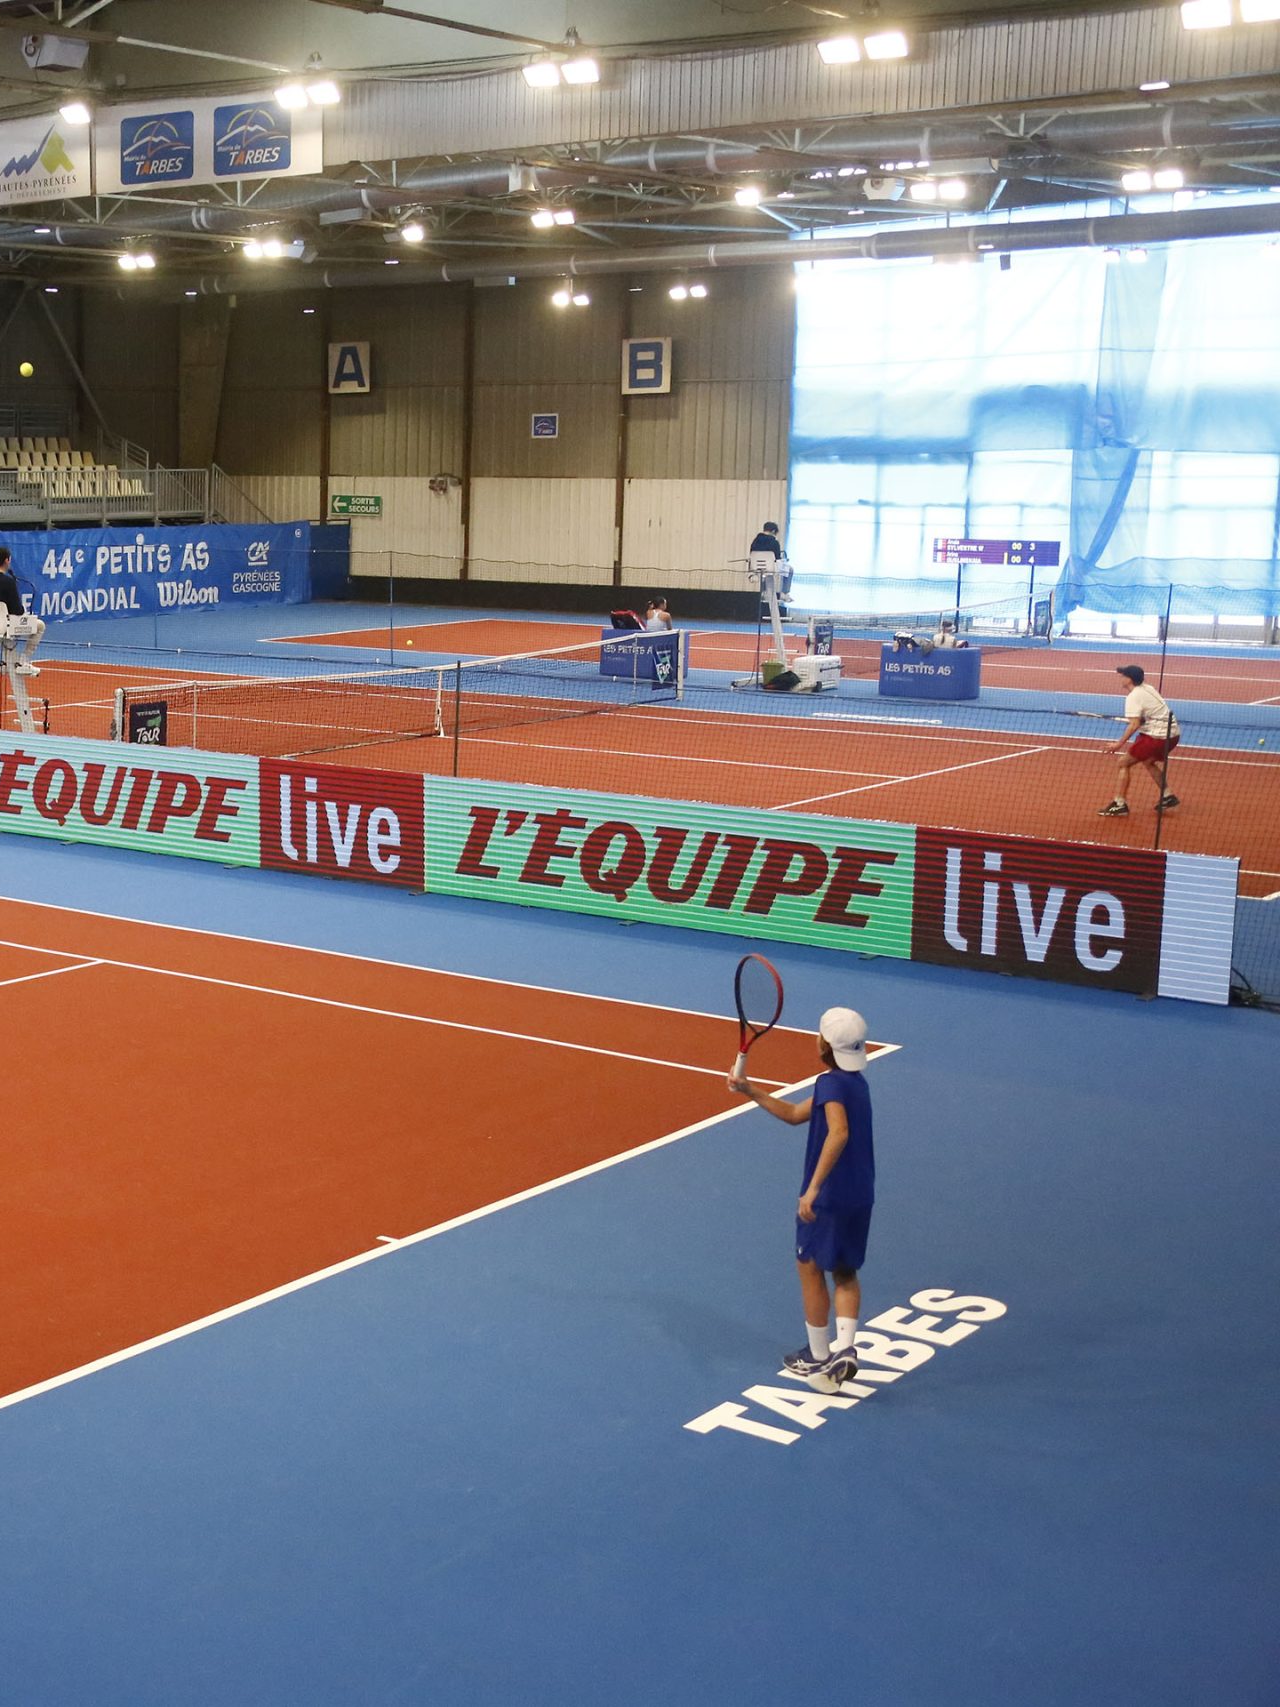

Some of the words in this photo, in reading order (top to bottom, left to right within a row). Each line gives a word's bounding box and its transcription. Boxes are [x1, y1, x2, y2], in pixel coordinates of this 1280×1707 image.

[229, 147, 280, 166] TARBES
[135, 157, 184, 176] TARBES
[332, 346, 366, 389] A
[629, 342, 663, 389] B
[348, 505, 380, 513] SECOURS
[351, 497, 375, 505] SORTIE
[42, 549, 85, 579] 44e
[96, 533, 171, 575] PETITS
[180, 541, 210, 572] AS
[1011, 542, 1022, 551] 00
[1029, 542, 1036, 551] 3
[1010, 555, 1022, 564] 00
[233, 569, 281, 583] PYRÉNÉES
[232, 582, 281, 593] GASCOGNE
[40, 585, 141, 616] MONDIAL
[157, 580, 220, 608] Wilson
[885, 662, 900, 672] LES
[902, 661, 935, 675] PETITS
[936, 665, 952, 676] AS
[279, 774, 401, 874] live
[455, 805, 900, 929] L'ÉQUIPE
[942, 847, 1126, 972] live
